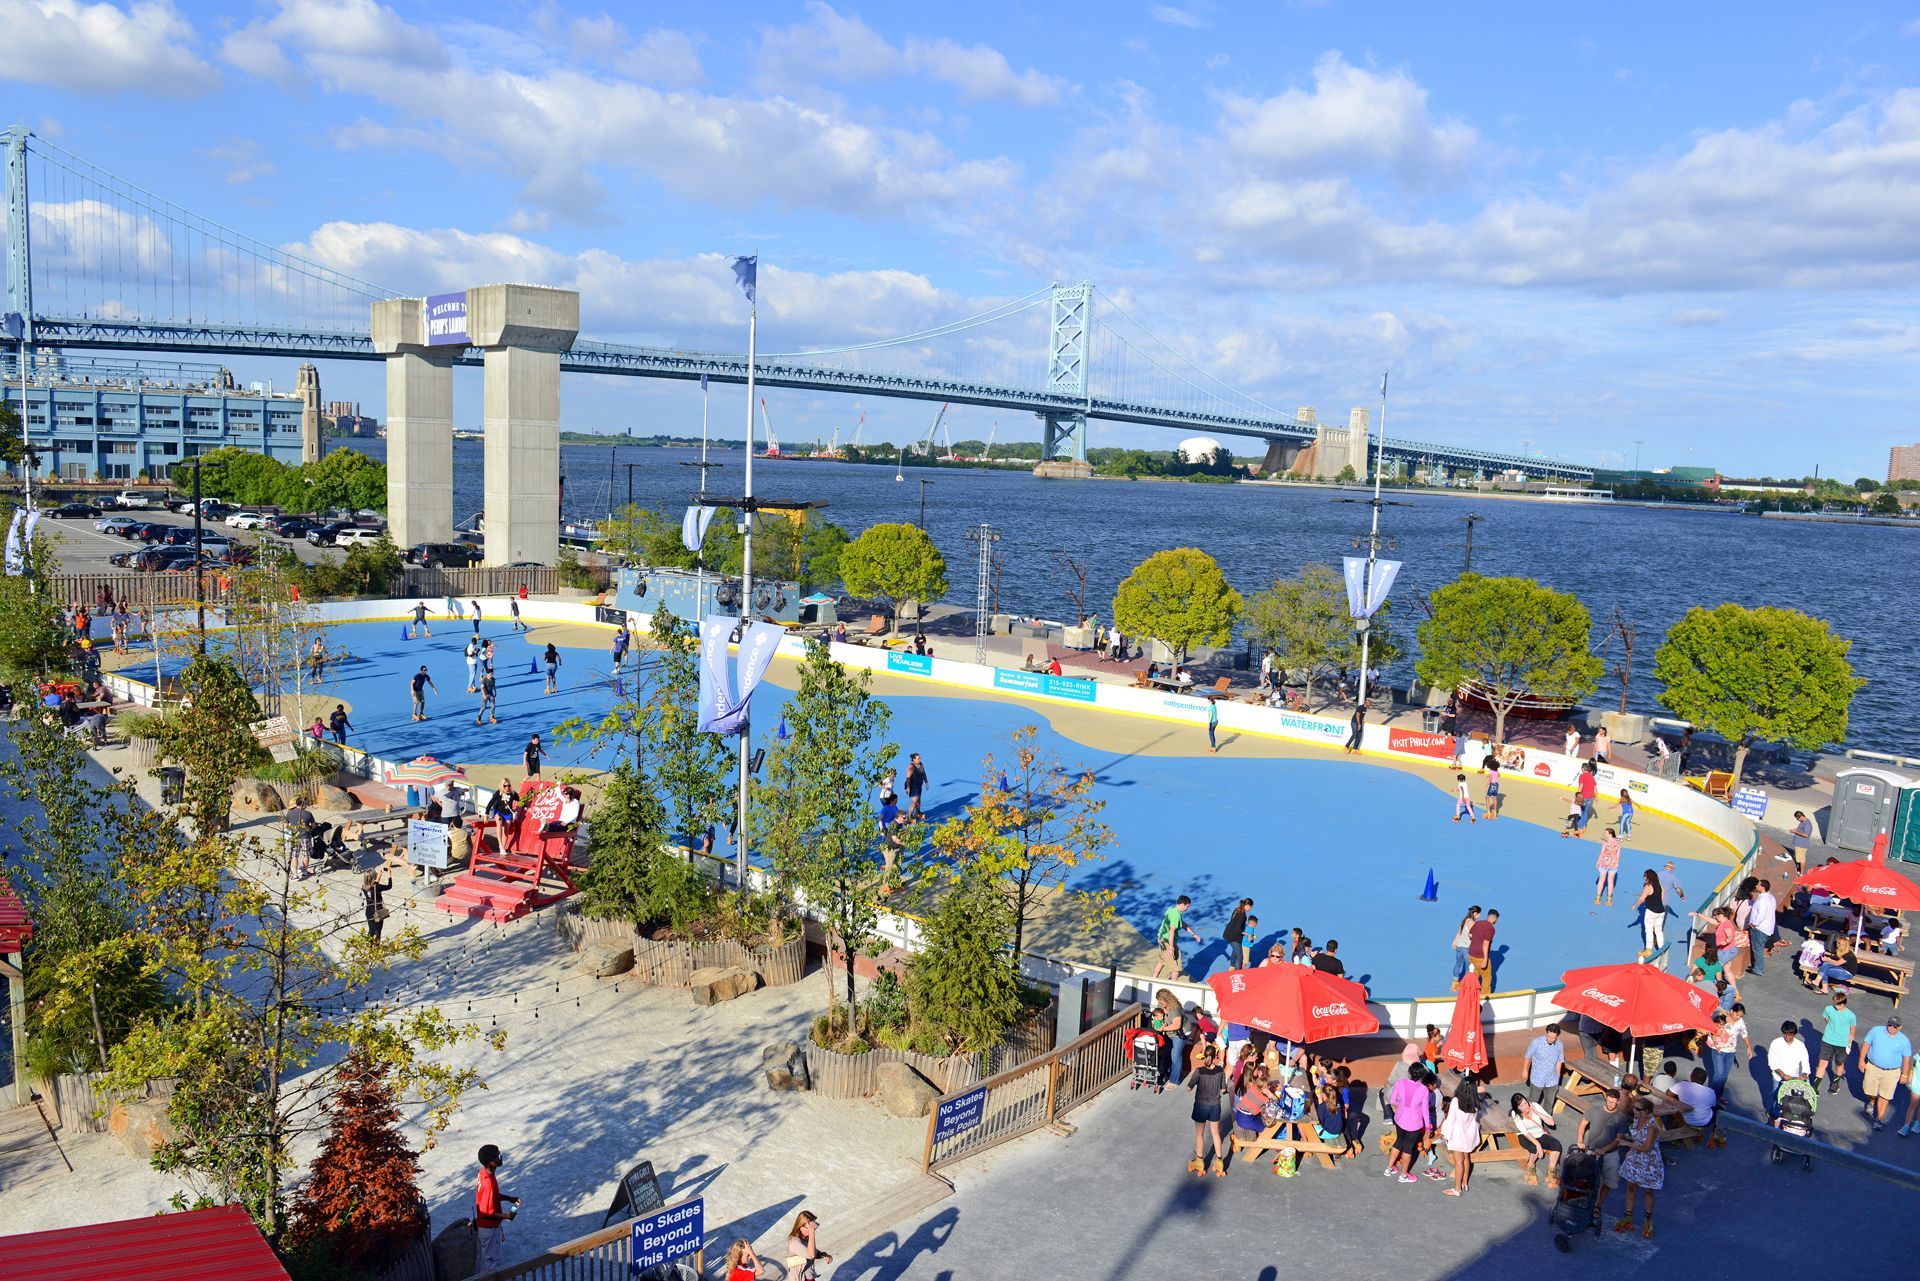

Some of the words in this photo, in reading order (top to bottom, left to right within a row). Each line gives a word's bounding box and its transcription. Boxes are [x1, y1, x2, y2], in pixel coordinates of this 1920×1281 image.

[433, 302, 460, 316] WELCOME
[430, 318, 448, 335] PENN'S
[449, 316, 467, 334] LANDI
[1459, 689, 1468, 701] 37
[267, 725, 291, 737] ATM
[1281, 716, 1345, 735] WATERFRONT
[1737, 799, 1761, 809] Beyond
[1745, 794, 1766, 803] Skates
[1733, 805, 1746, 813] This
[1747, 808, 1764, 816] Point
[1862, 885, 1897, 896] Coca-Cola
[1581, 987, 1626, 1008] Coca-Cola
[1312, 1002, 1350, 1018] Coca-Cola
[1251, 1017, 1273, 1030] Coca-Cola
[1662, 1023, 1684, 1031] Coca-Cola
[940, 1105, 953, 1117] No
[955, 1091, 984, 1110] Skates
[943, 1105, 977, 1127] Beyond
[936, 1128, 955, 1141] This
[956, 1116, 979, 1133] Point
[635, 1224, 654, 1238] No
[657, 1205, 701, 1228] Skates
[643, 1221, 693, 1251] Beyond
[635, 1251, 664, 1270] This
[667, 1235, 700, 1258] Point
